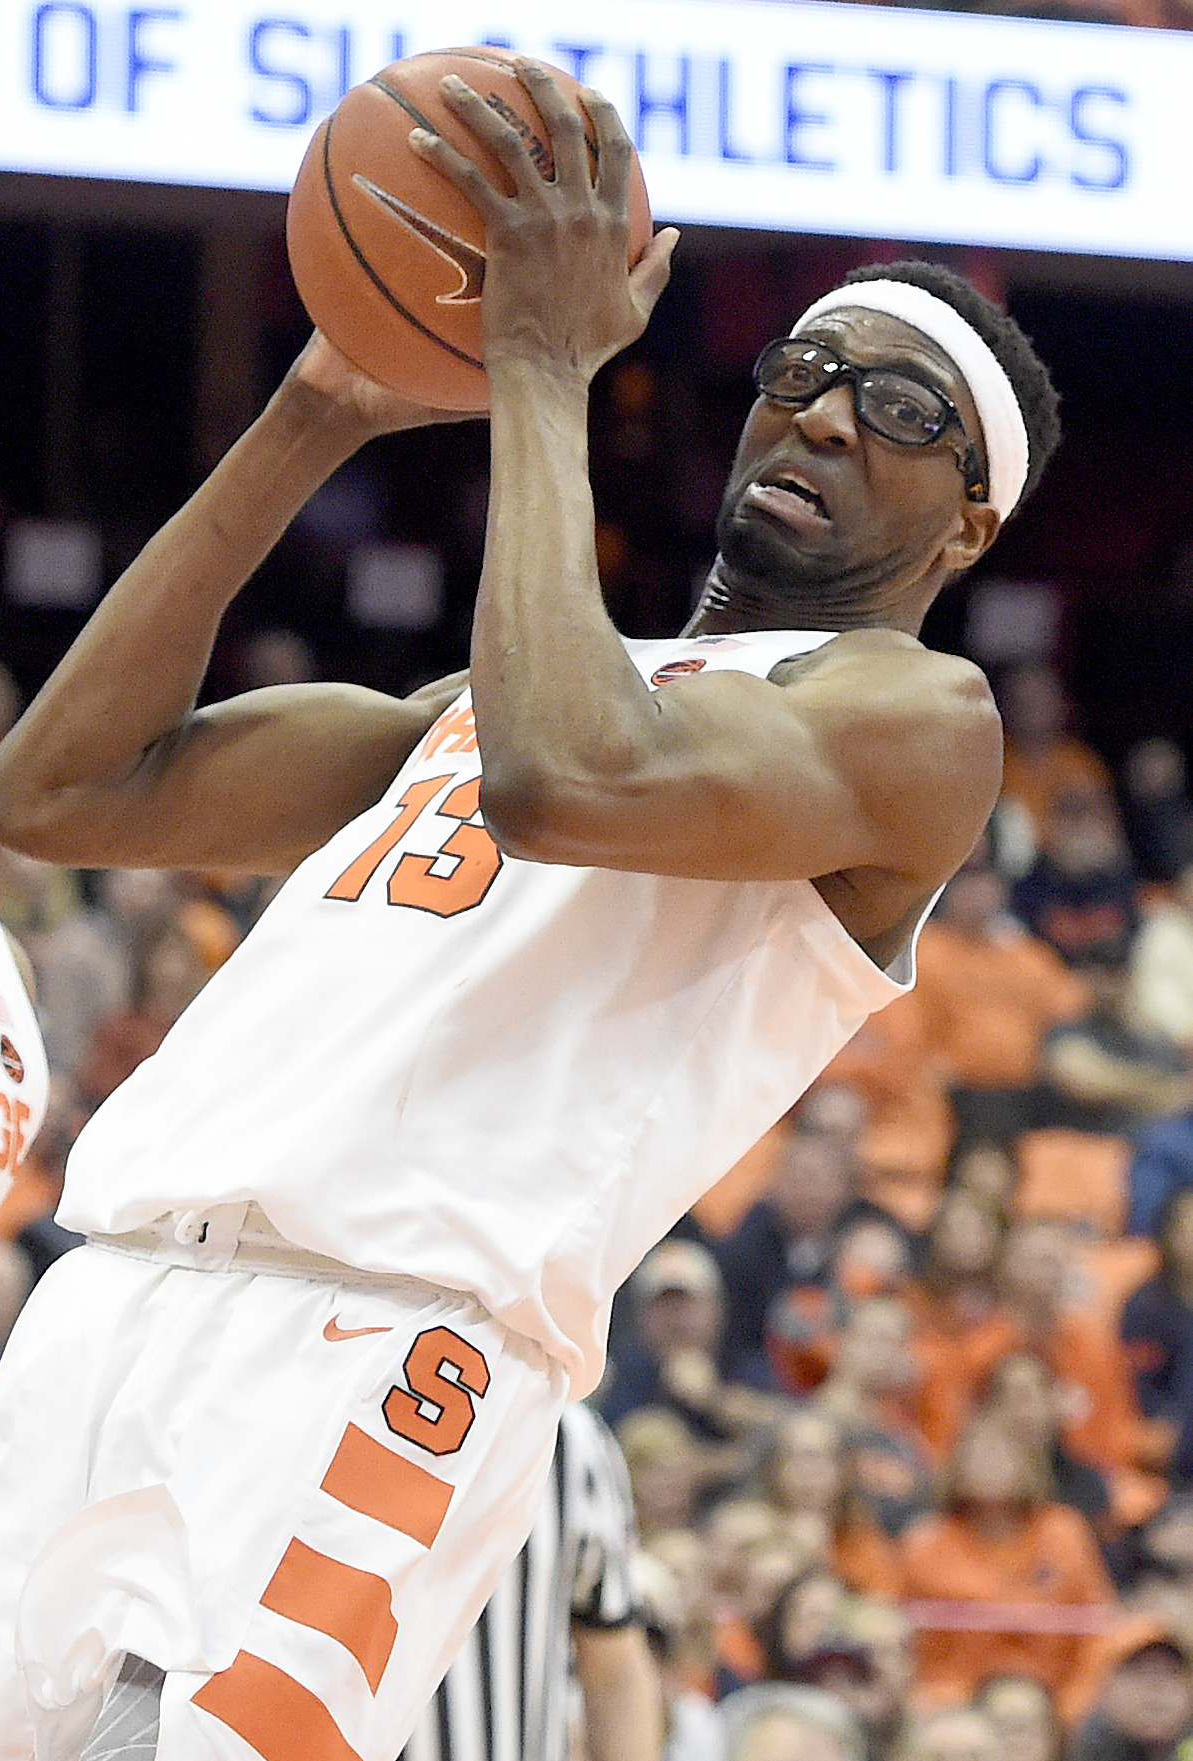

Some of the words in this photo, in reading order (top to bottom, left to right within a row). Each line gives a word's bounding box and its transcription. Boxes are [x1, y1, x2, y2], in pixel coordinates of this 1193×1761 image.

[34, 3, 184, 112] OF
[481, 38, 1128, 190] THLETICS
[323, 772, 504, 919] 13
[382, 1325, 492, 1457] S
